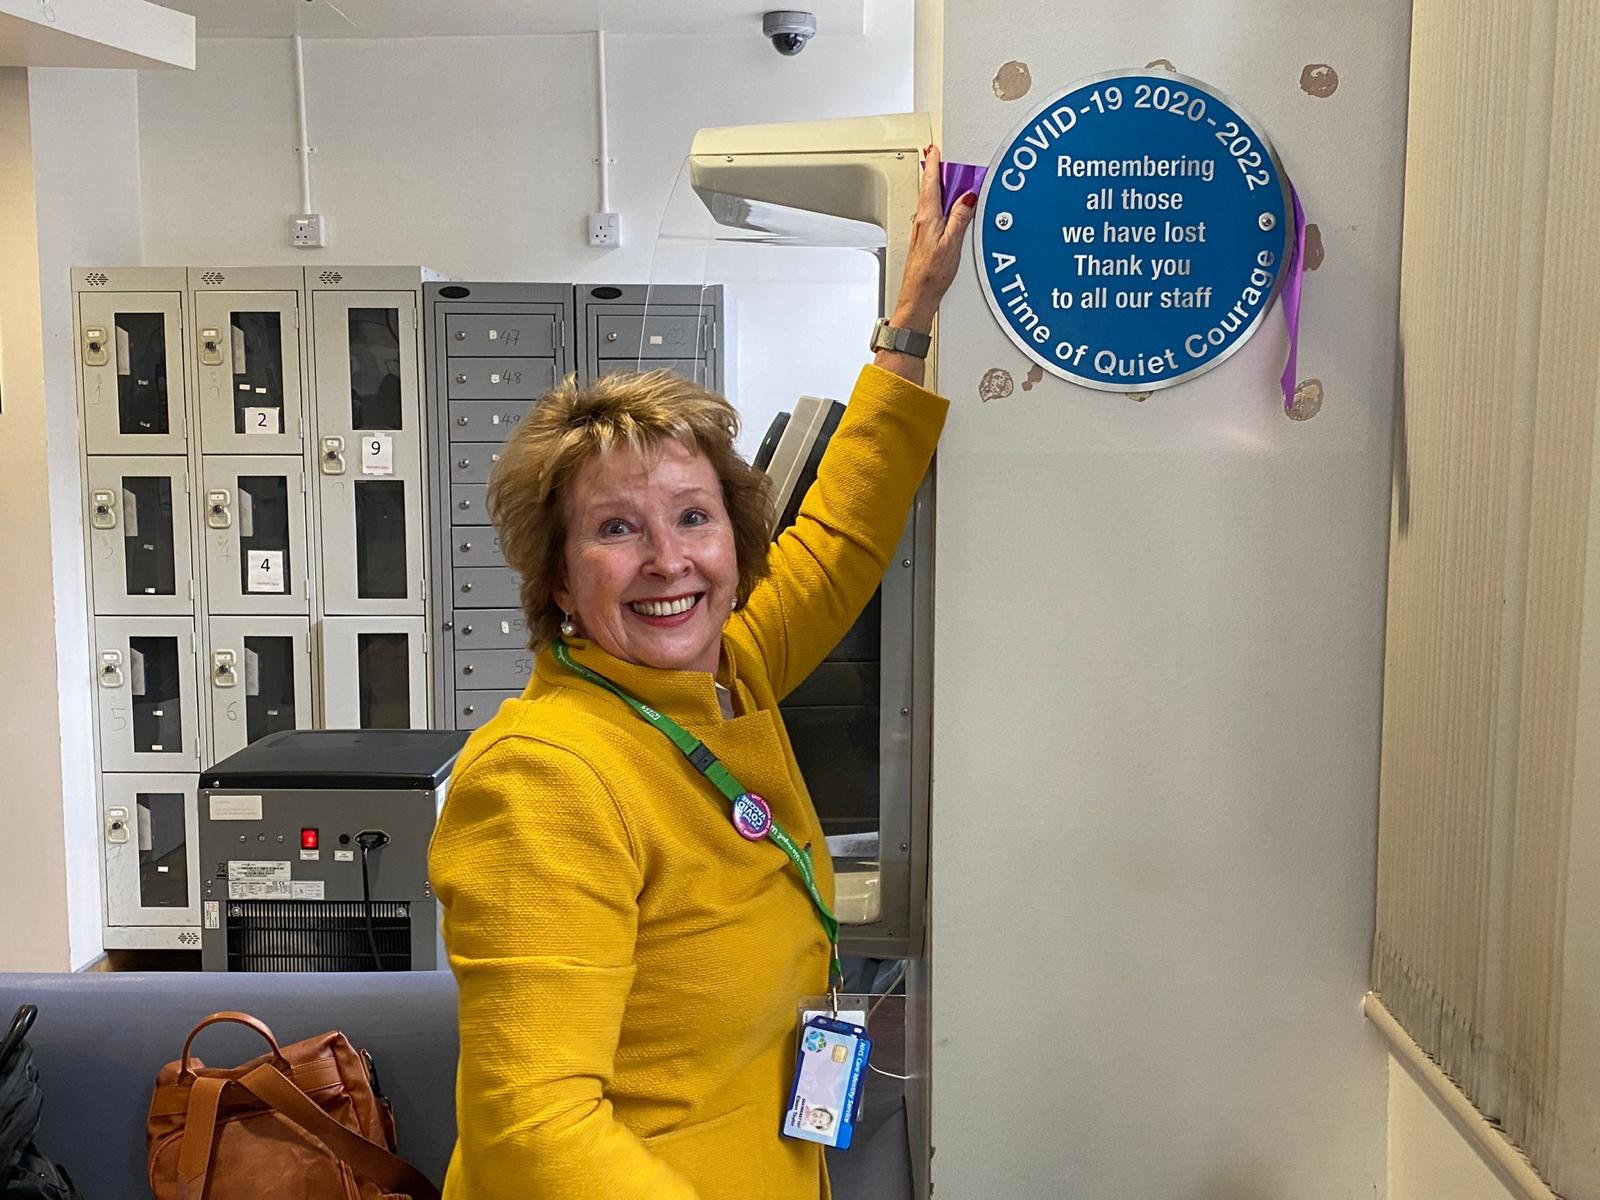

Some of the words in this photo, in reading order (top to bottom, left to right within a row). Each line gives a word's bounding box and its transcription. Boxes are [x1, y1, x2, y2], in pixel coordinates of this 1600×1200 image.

[1001, 86, 1123, 192] COVID-19
[1134, 84, 1270, 191] 2020-2022
[1057, 155, 1215, 182] Remembering
[1086, 188, 1113, 210] all
[1121, 188, 1183, 210] those
[1062, 225, 1095, 243] we
[1103, 222, 1156, 243] have
[1164, 222, 1206, 243] lost
[991, 251, 1017, 273] A
[1074, 254, 1143, 276] Thank
[1151, 259, 1191, 280] you
[1001, 274, 1050, 343] Time
[1052, 288, 1073, 309] to
[1080, 287, 1107, 308] all
[1115, 292, 1153, 309] our
[1160, 287, 1212, 309] staff
[1184, 249, 1275, 358] Courage
[500, 329, 520, 345] 47
[1055, 342, 1089, 367] of
[1094, 349, 1179, 376] Quiet
[502, 369, 522, 384] 48
[257, 412, 267, 427] 2
[501, 413, 521, 428] 49
[371, 441, 381, 456] 9
[260, 558, 271, 572] 4
[514, 658, 532, 675] 55
[111, 707, 126, 732] 5
[226, 701, 238, 721] 6
